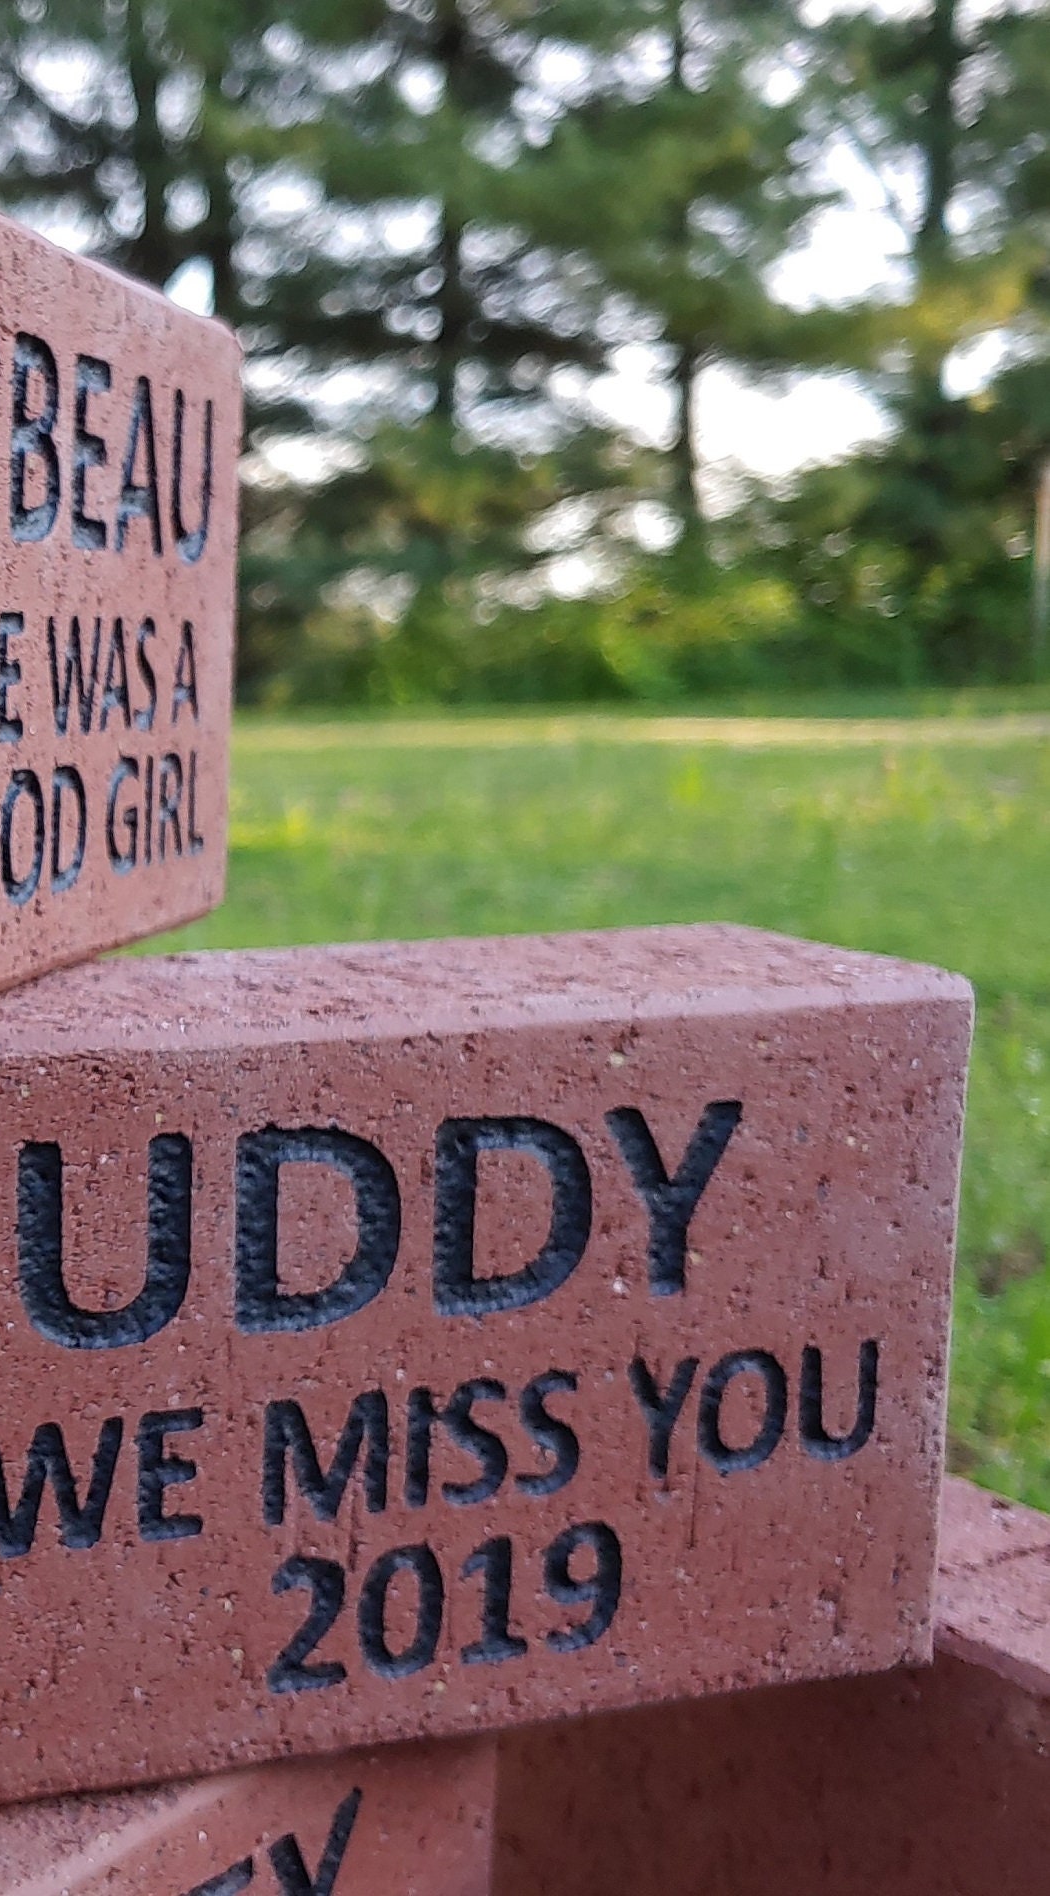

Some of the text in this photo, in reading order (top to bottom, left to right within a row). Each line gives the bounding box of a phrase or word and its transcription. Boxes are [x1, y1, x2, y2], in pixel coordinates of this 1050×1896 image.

[47, 616, 156, 737] WAS
[171, 620, 200, 723] A
[106, 751, 204, 875] GIRL
[263, 1369, 580, 1526] MISS
[628, 1338, 880, 1479] YOU
[266, 1520, 623, 1694] 2019
